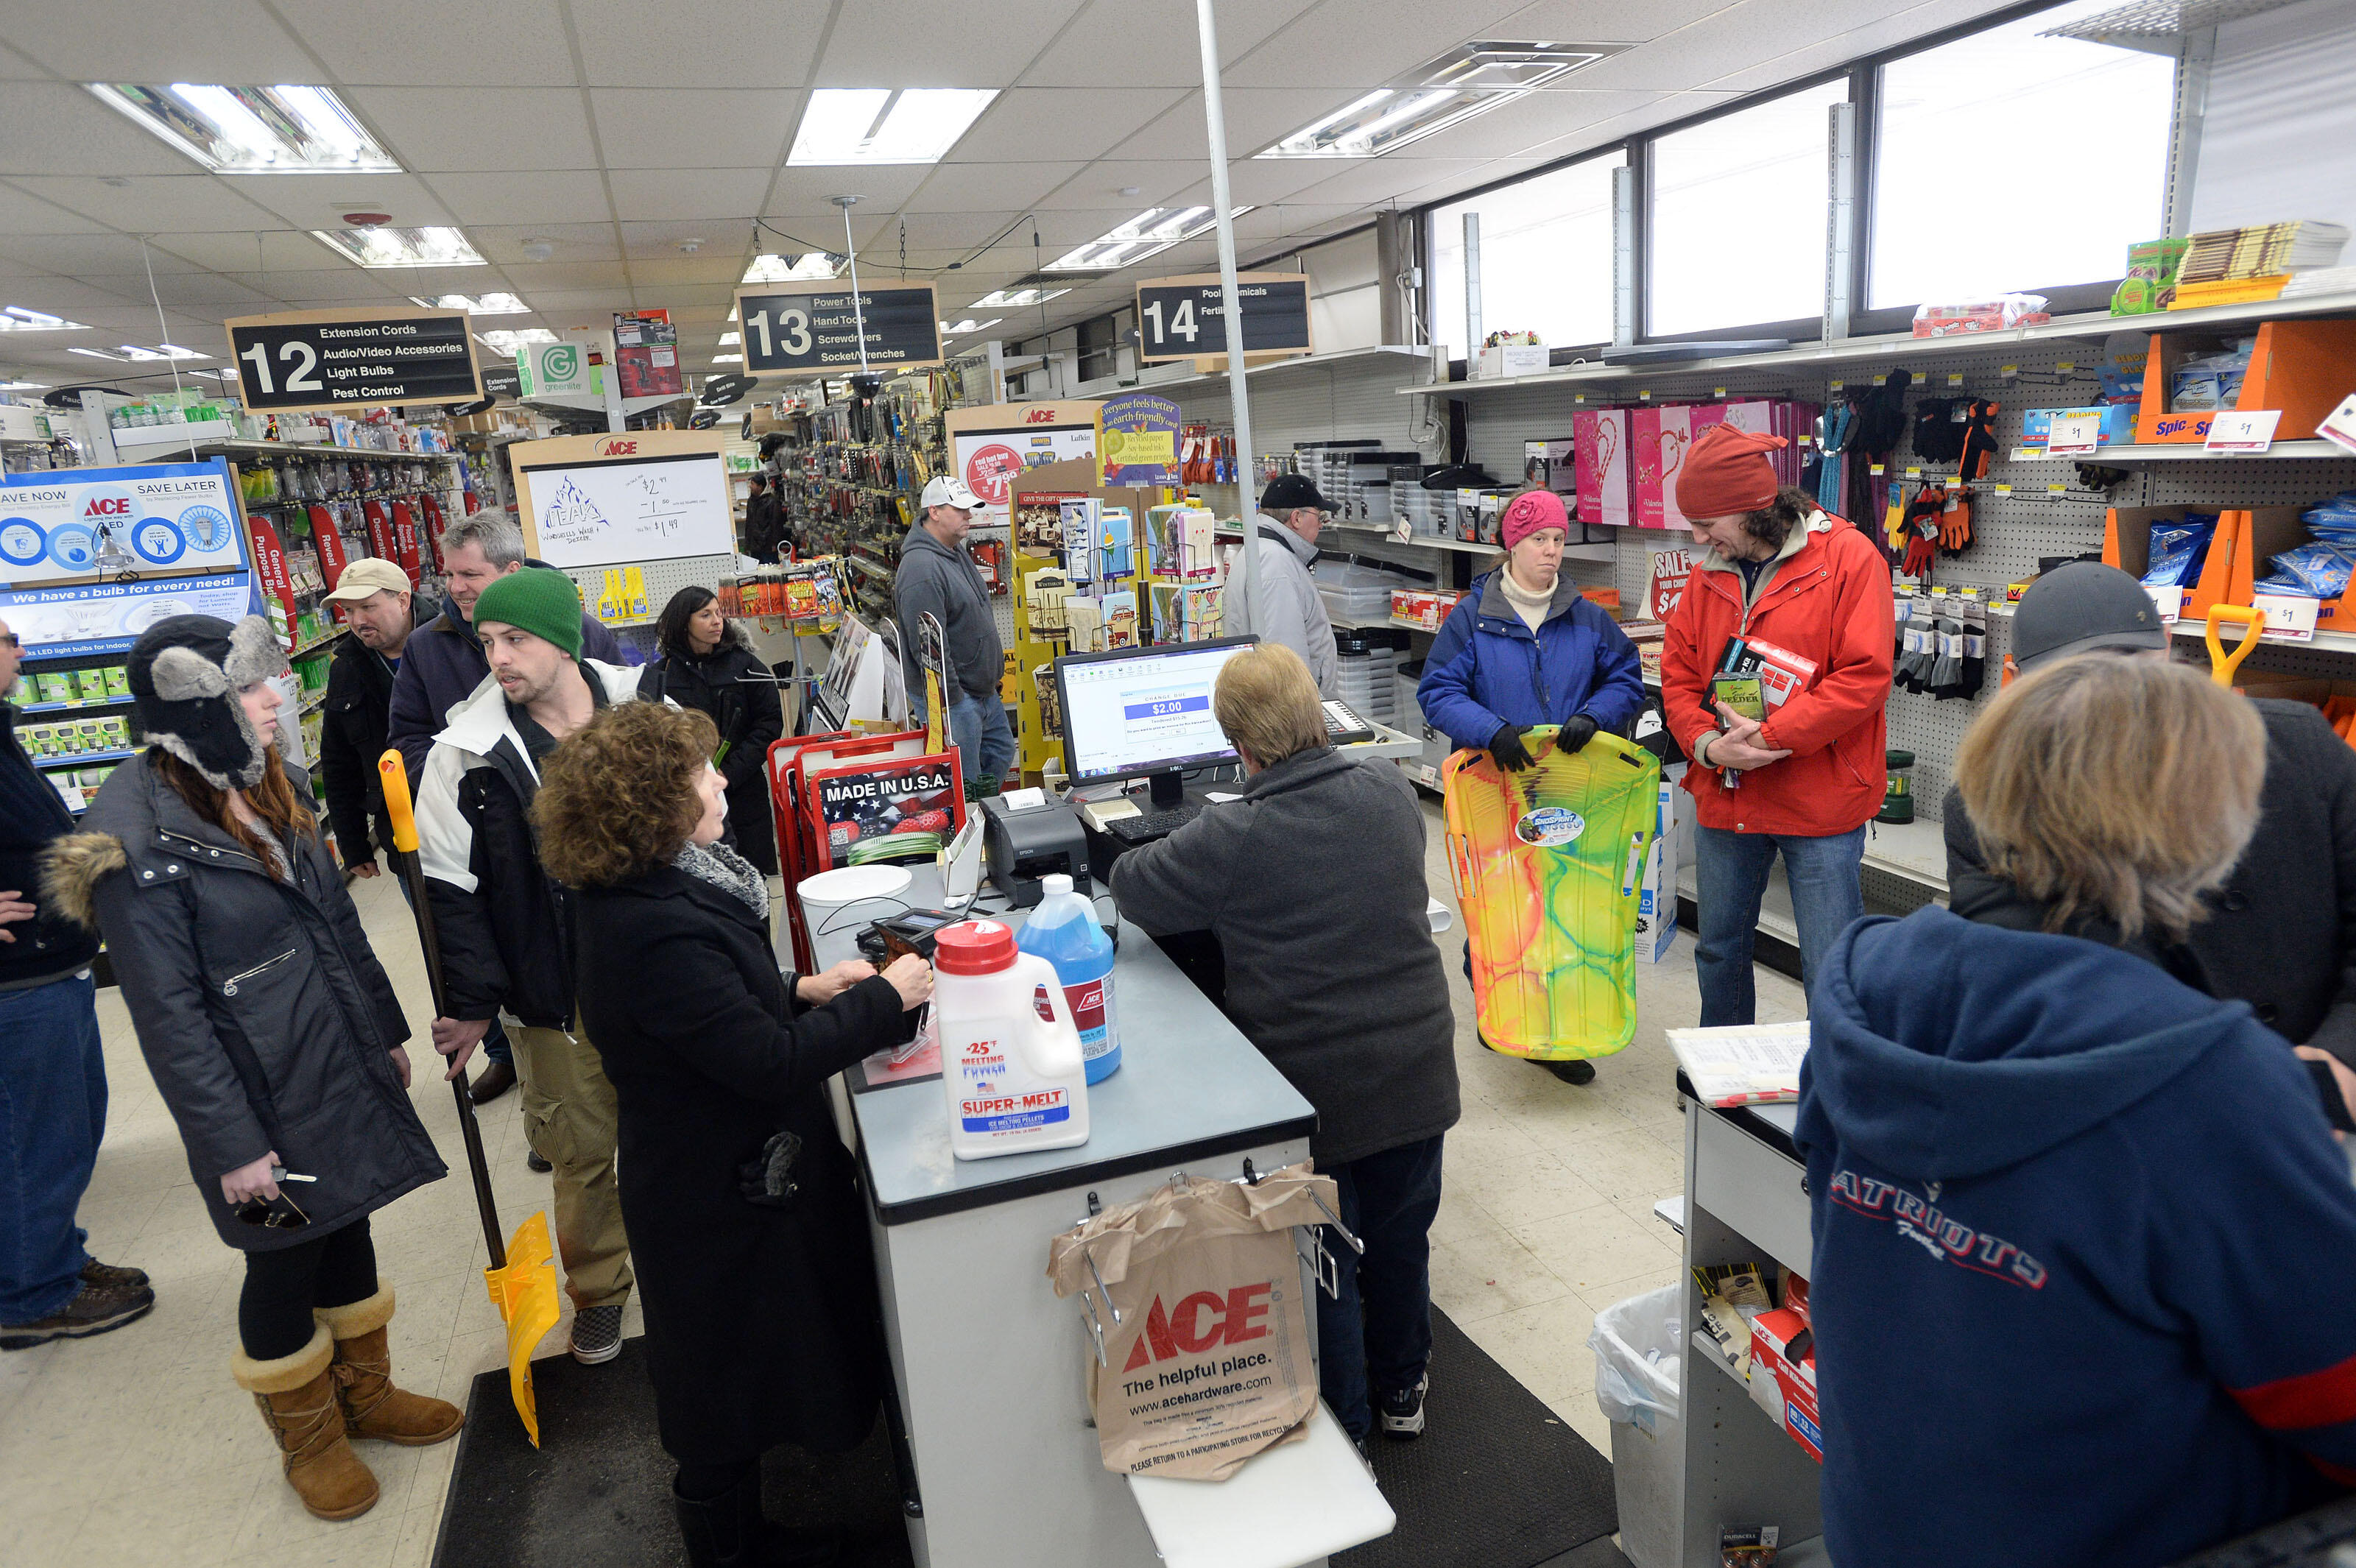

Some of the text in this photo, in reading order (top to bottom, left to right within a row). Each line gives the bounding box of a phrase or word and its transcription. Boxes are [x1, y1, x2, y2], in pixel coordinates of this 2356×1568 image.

[1202, 287, 1267, 298] Pool emicals
[814, 297, 844, 307] Power
[1202, 306, 1243, 316] Fertilis
[813, 315, 867, 326] Hand Toos
[1144, 299, 1199, 344] 14
[320, 325, 417, 339] Extension Cords
[747, 308, 812, 356] 13
[818, 333, 882, 345] Screwdrvers
[323, 343, 463, 360] Audio/Video Accessories
[2115, 353, 2148, 363] READI
[241, 341, 323, 393] 12
[327, 365, 394, 380] Light Bulbs
[487, 376, 517, 386] Extension
[545, 382, 581, 392] greenlite
[333, 385, 404, 398] Pest Control
[62, 395, 82, 404] Fauc
[1101, 398, 1175, 417] Everyone feels better
[1026, 409, 1055, 423] ACE
[1113, 412, 1165, 425] earth-friendly
[2073, 427, 2081, 439] $1
[2156, 420, 2213, 436] Spic Sp
[2240, 423, 2251, 435] $1
[1149, 434, 1164, 443] paper
[604, 441, 637, 456] ACE
[1153, 443, 1164, 451] inks
[1, 481, 216, 503] AVE NOW SAVE LATER
[84, 498, 130, 516] ACE
[108, 520, 124, 529] ED
[398, 523, 408, 554] Spotlight
[405, 524, 414, 543] Flood
[322, 534, 337, 566] Reveal
[255, 535, 278, 598] Purpose Bul
[269, 549, 286, 589] General
[1655, 549, 1691, 579] SALE
[2154, 561, 2184, 572] USTER
[13, 577, 234, 603] We have a bulb for every need!
[1659, 578, 1688, 590] YOUR CHOIC
[633, 598, 645, 607] HEET
[2283, 610, 2293, 623] $1
[2318, 607, 2334, 618] an
[1642, 651, 1662, 660] WHOPP
[1743, 657, 1752, 667] Kit
[1721, 696, 1759, 704] FEEDER
[1152, 702, 1182, 715] $2.00
[826, 774, 949, 802] MADE IN U.S.A.
[1087, 994, 1101, 1003] ACE
[966, 1042, 990, 1055] -25
[962, 1055, 1004, 1066] MELTING
[963, 1063, 1006, 1080] POWER
[962, 1091, 1061, 1115] SUPER-MELT
[998, 1117, 1021, 1126] MELTING
[1022, 1115, 1044, 1124] PELLETS
[1831, 1170, 2048, 1290] ATRIOTS
[1122, 1282, 1272, 1374] ACE
[1755, 1327, 1771, 1343] ACE
[1123, 1352, 1272, 1397] The helpful place.
[1777, 1358, 1815, 1398] Tall Kitchen
[1129, 1376, 1272, 1416] www.acehardware.com
[1131, 1459, 1153, 1472] PLEASE
[1153, 1453, 1176, 1466] RETURN
[1177, 1451, 1185, 1460] TO
[1191, 1441, 1230, 1456] PARTICIPATING
[1230, 1435, 1249, 1447] STORE
[1250, 1431, 1261, 1441] FOR
